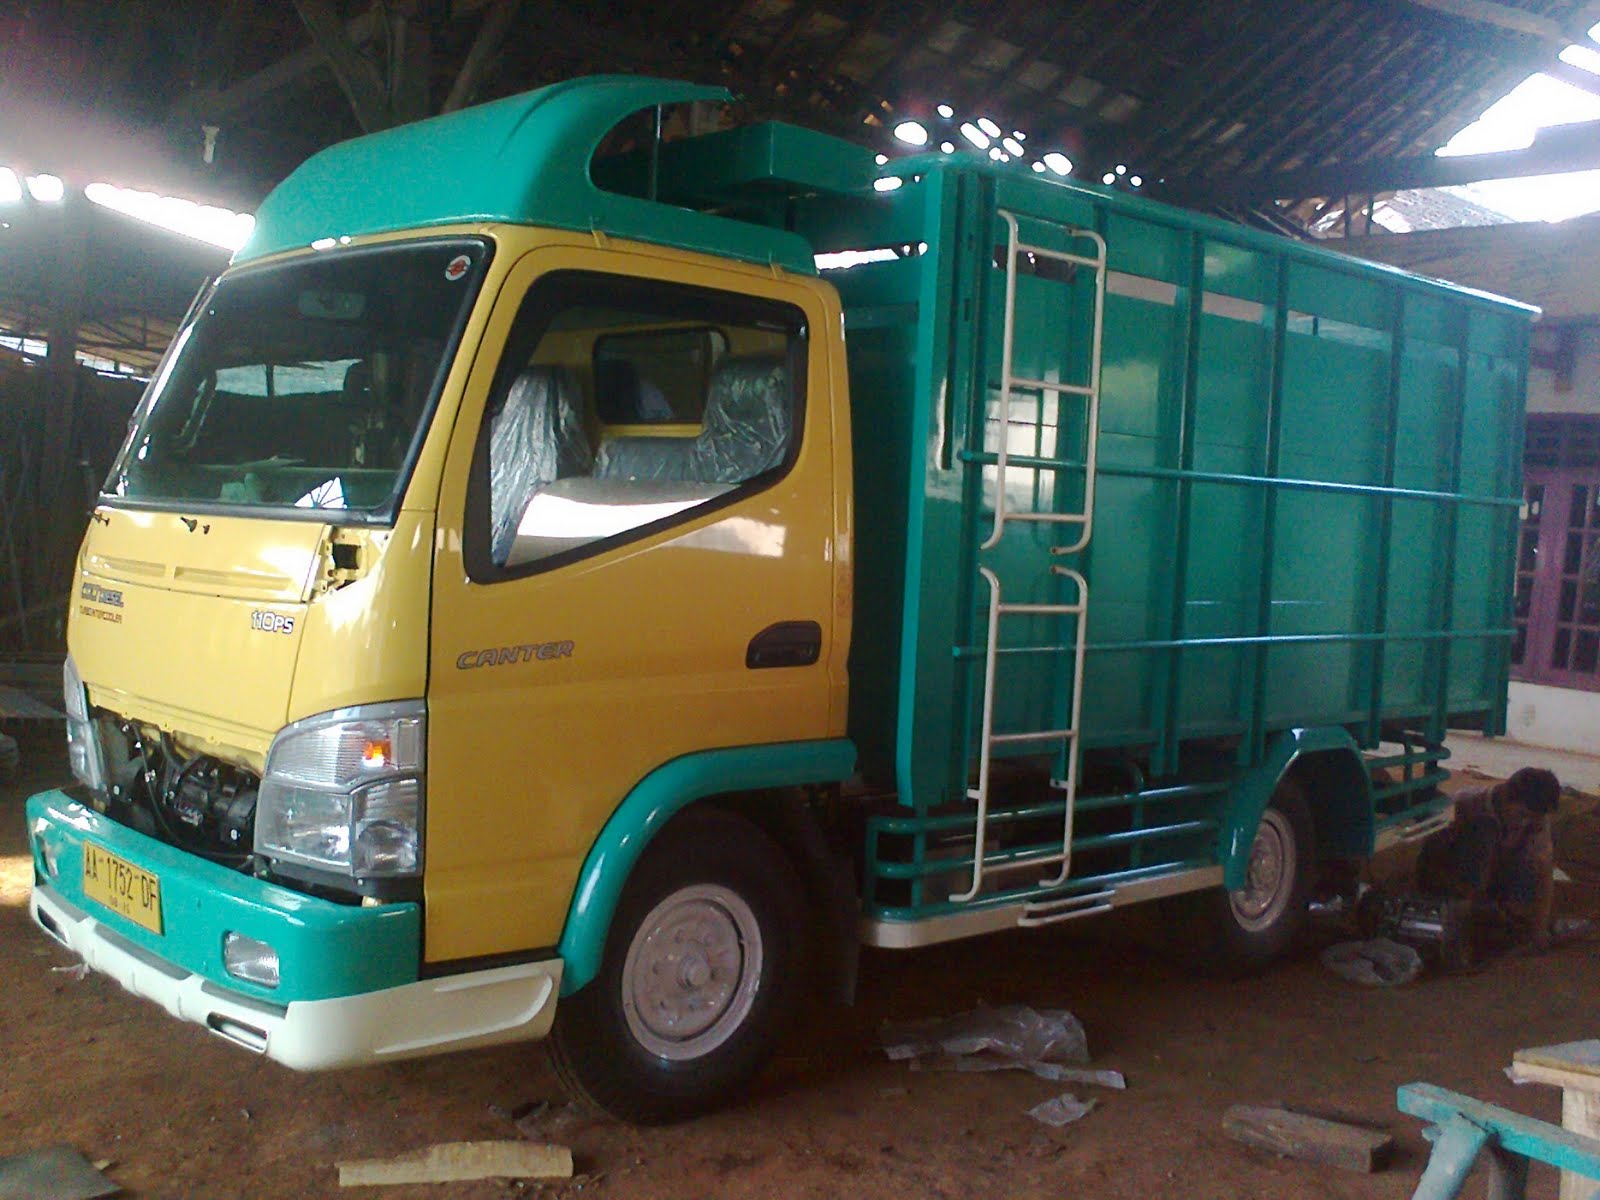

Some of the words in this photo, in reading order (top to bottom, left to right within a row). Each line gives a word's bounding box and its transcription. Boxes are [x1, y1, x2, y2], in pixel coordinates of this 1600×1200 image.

[251, 609, 295, 634] 110PS
[456, 640, 575, 669] CANTER
[107, 857, 133, 901] 1752
